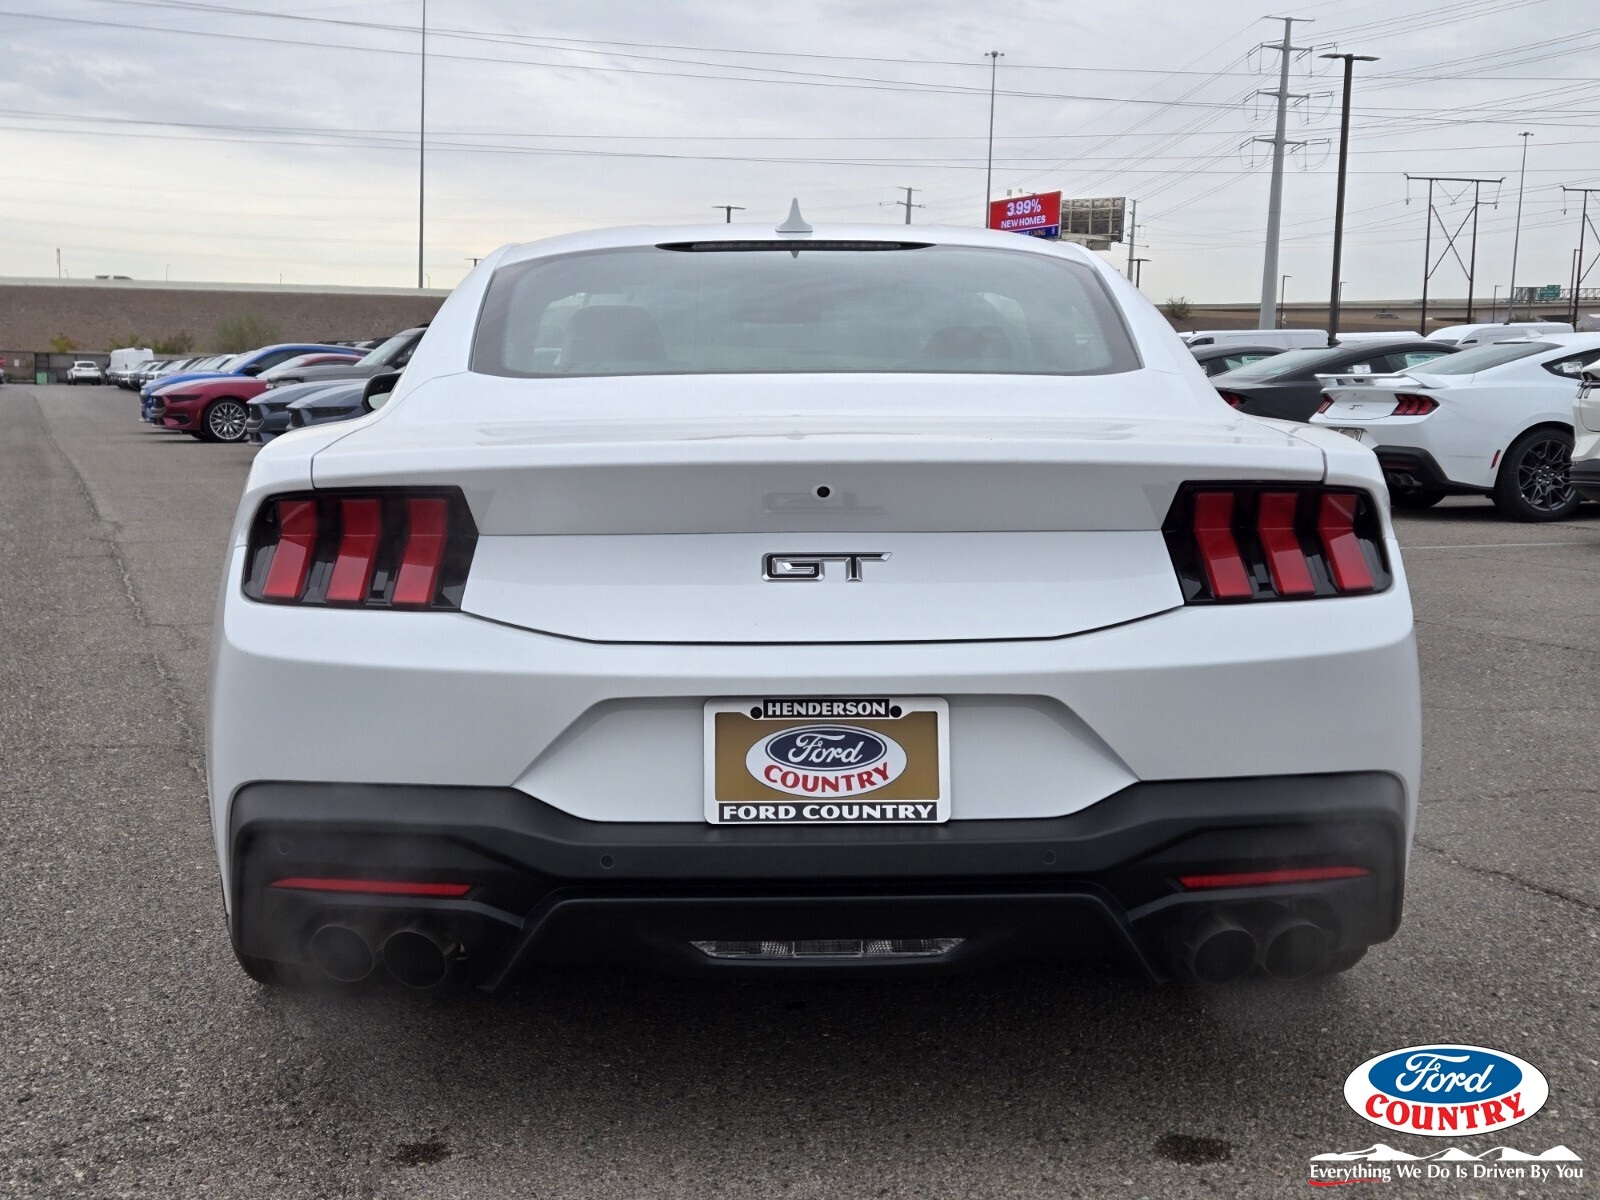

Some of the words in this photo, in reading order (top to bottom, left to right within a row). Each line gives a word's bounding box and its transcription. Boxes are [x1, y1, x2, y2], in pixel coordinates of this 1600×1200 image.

[1006, 199, 1041, 216] 3.99%
[1001, 220, 1018, 228] NEW
[1020, 215, 1046, 226] HOMES
[761, 552, 892, 582] GT
[767, 702, 886, 716] HENDERSON
[788, 733, 865, 763] Ford
[763, 762, 890, 793] COUNTRY
[723, 805, 797, 820] FORD
[802, 804, 934, 820] COUNTRY
